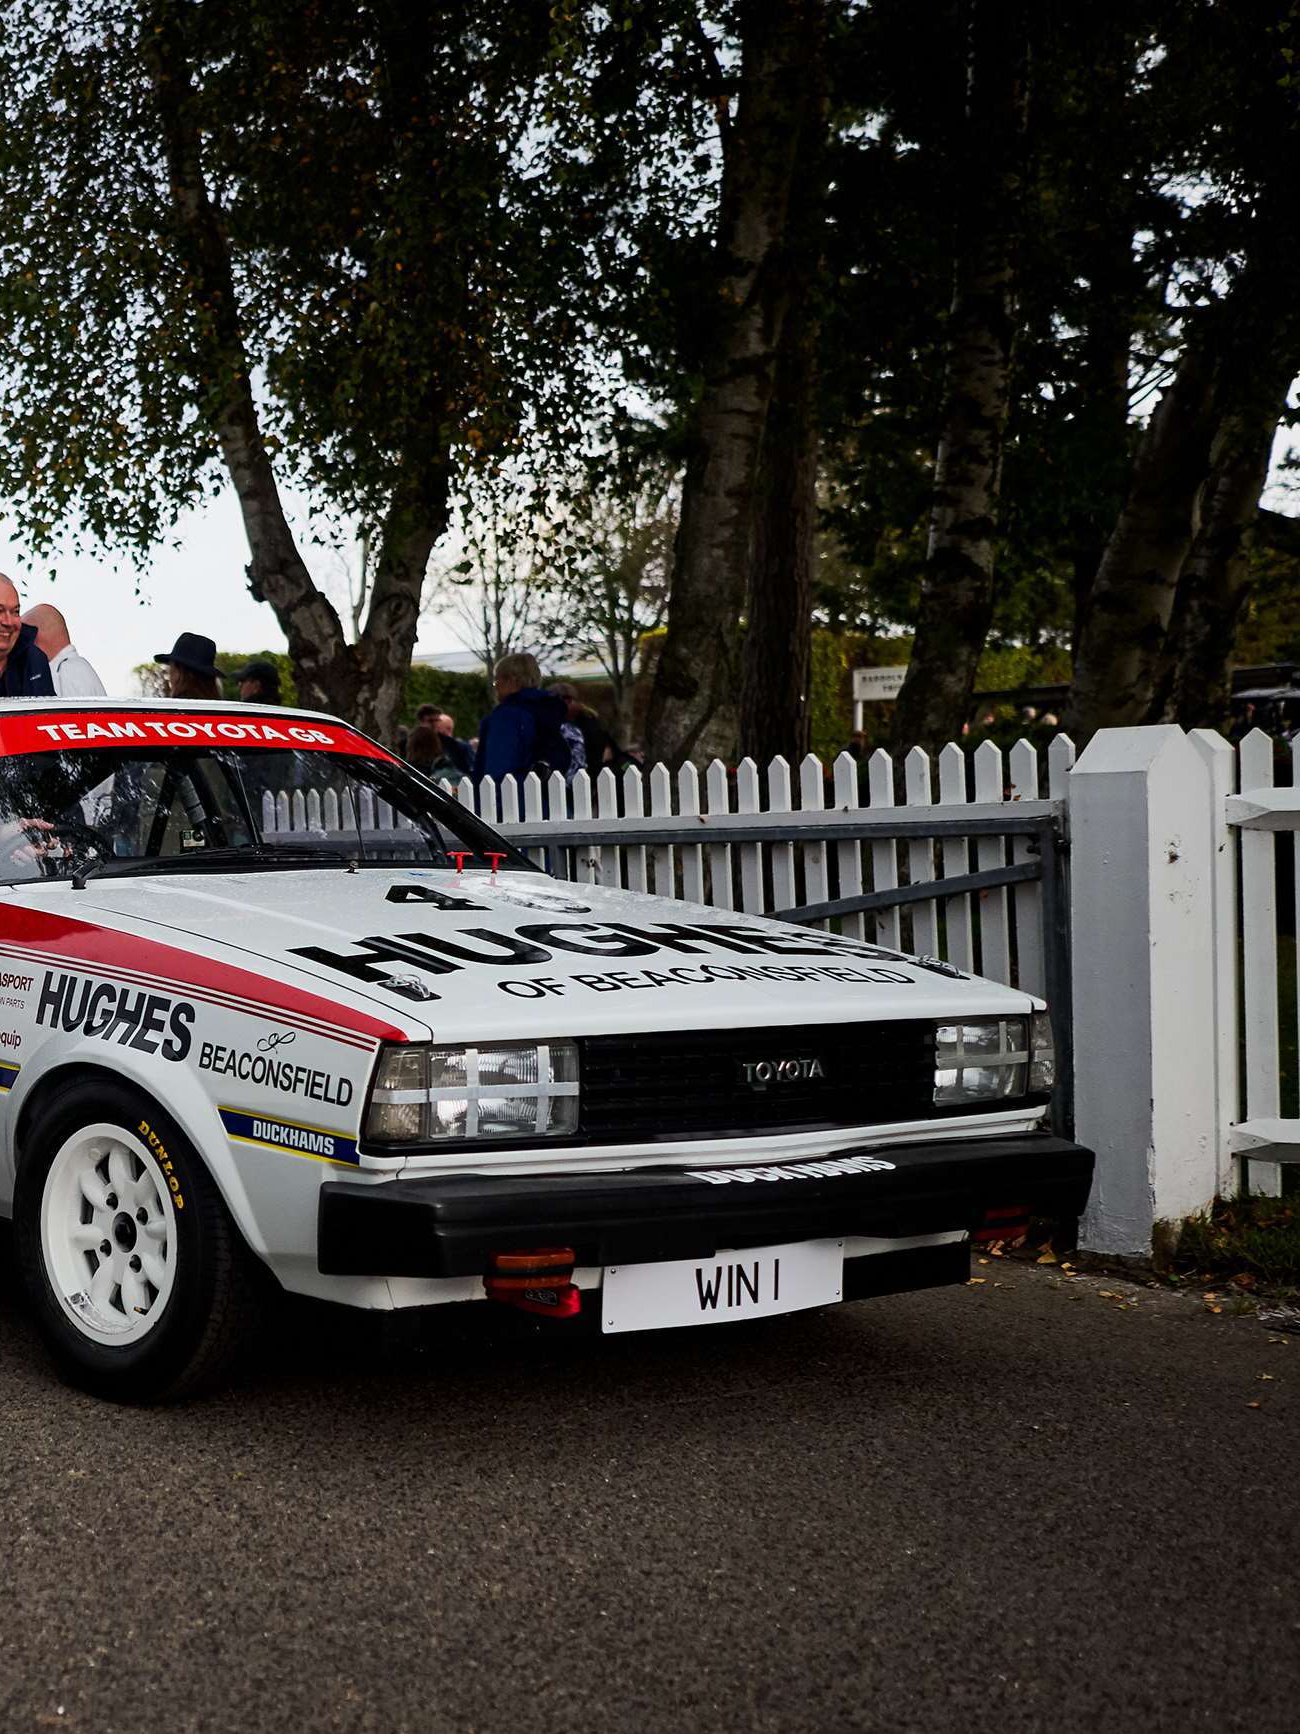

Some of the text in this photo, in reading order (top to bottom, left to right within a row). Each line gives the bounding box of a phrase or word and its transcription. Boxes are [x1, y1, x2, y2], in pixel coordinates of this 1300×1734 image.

[37, 721, 335, 745] TEAM TOYOTA GB
[285, 922, 910, 983] HUGHES
[496, 963, 916, 999] OF BEACONSFIELD
[5, 997, 25, 1010] PARTS
[35, 970, 196, 1062] HUGHES
[198, 1041, 353, 1107] BEACONSFIELD
[743, 1057, 826, 1083] TOYOTA
[252, 1119, 335, 1156] DUCKHAMS
[138, 1120, 184, 1209] DUNLOP
[683, 1154, 897, 1185] DUCKHAMS
[695, 1261, 760, 1311] WIN
